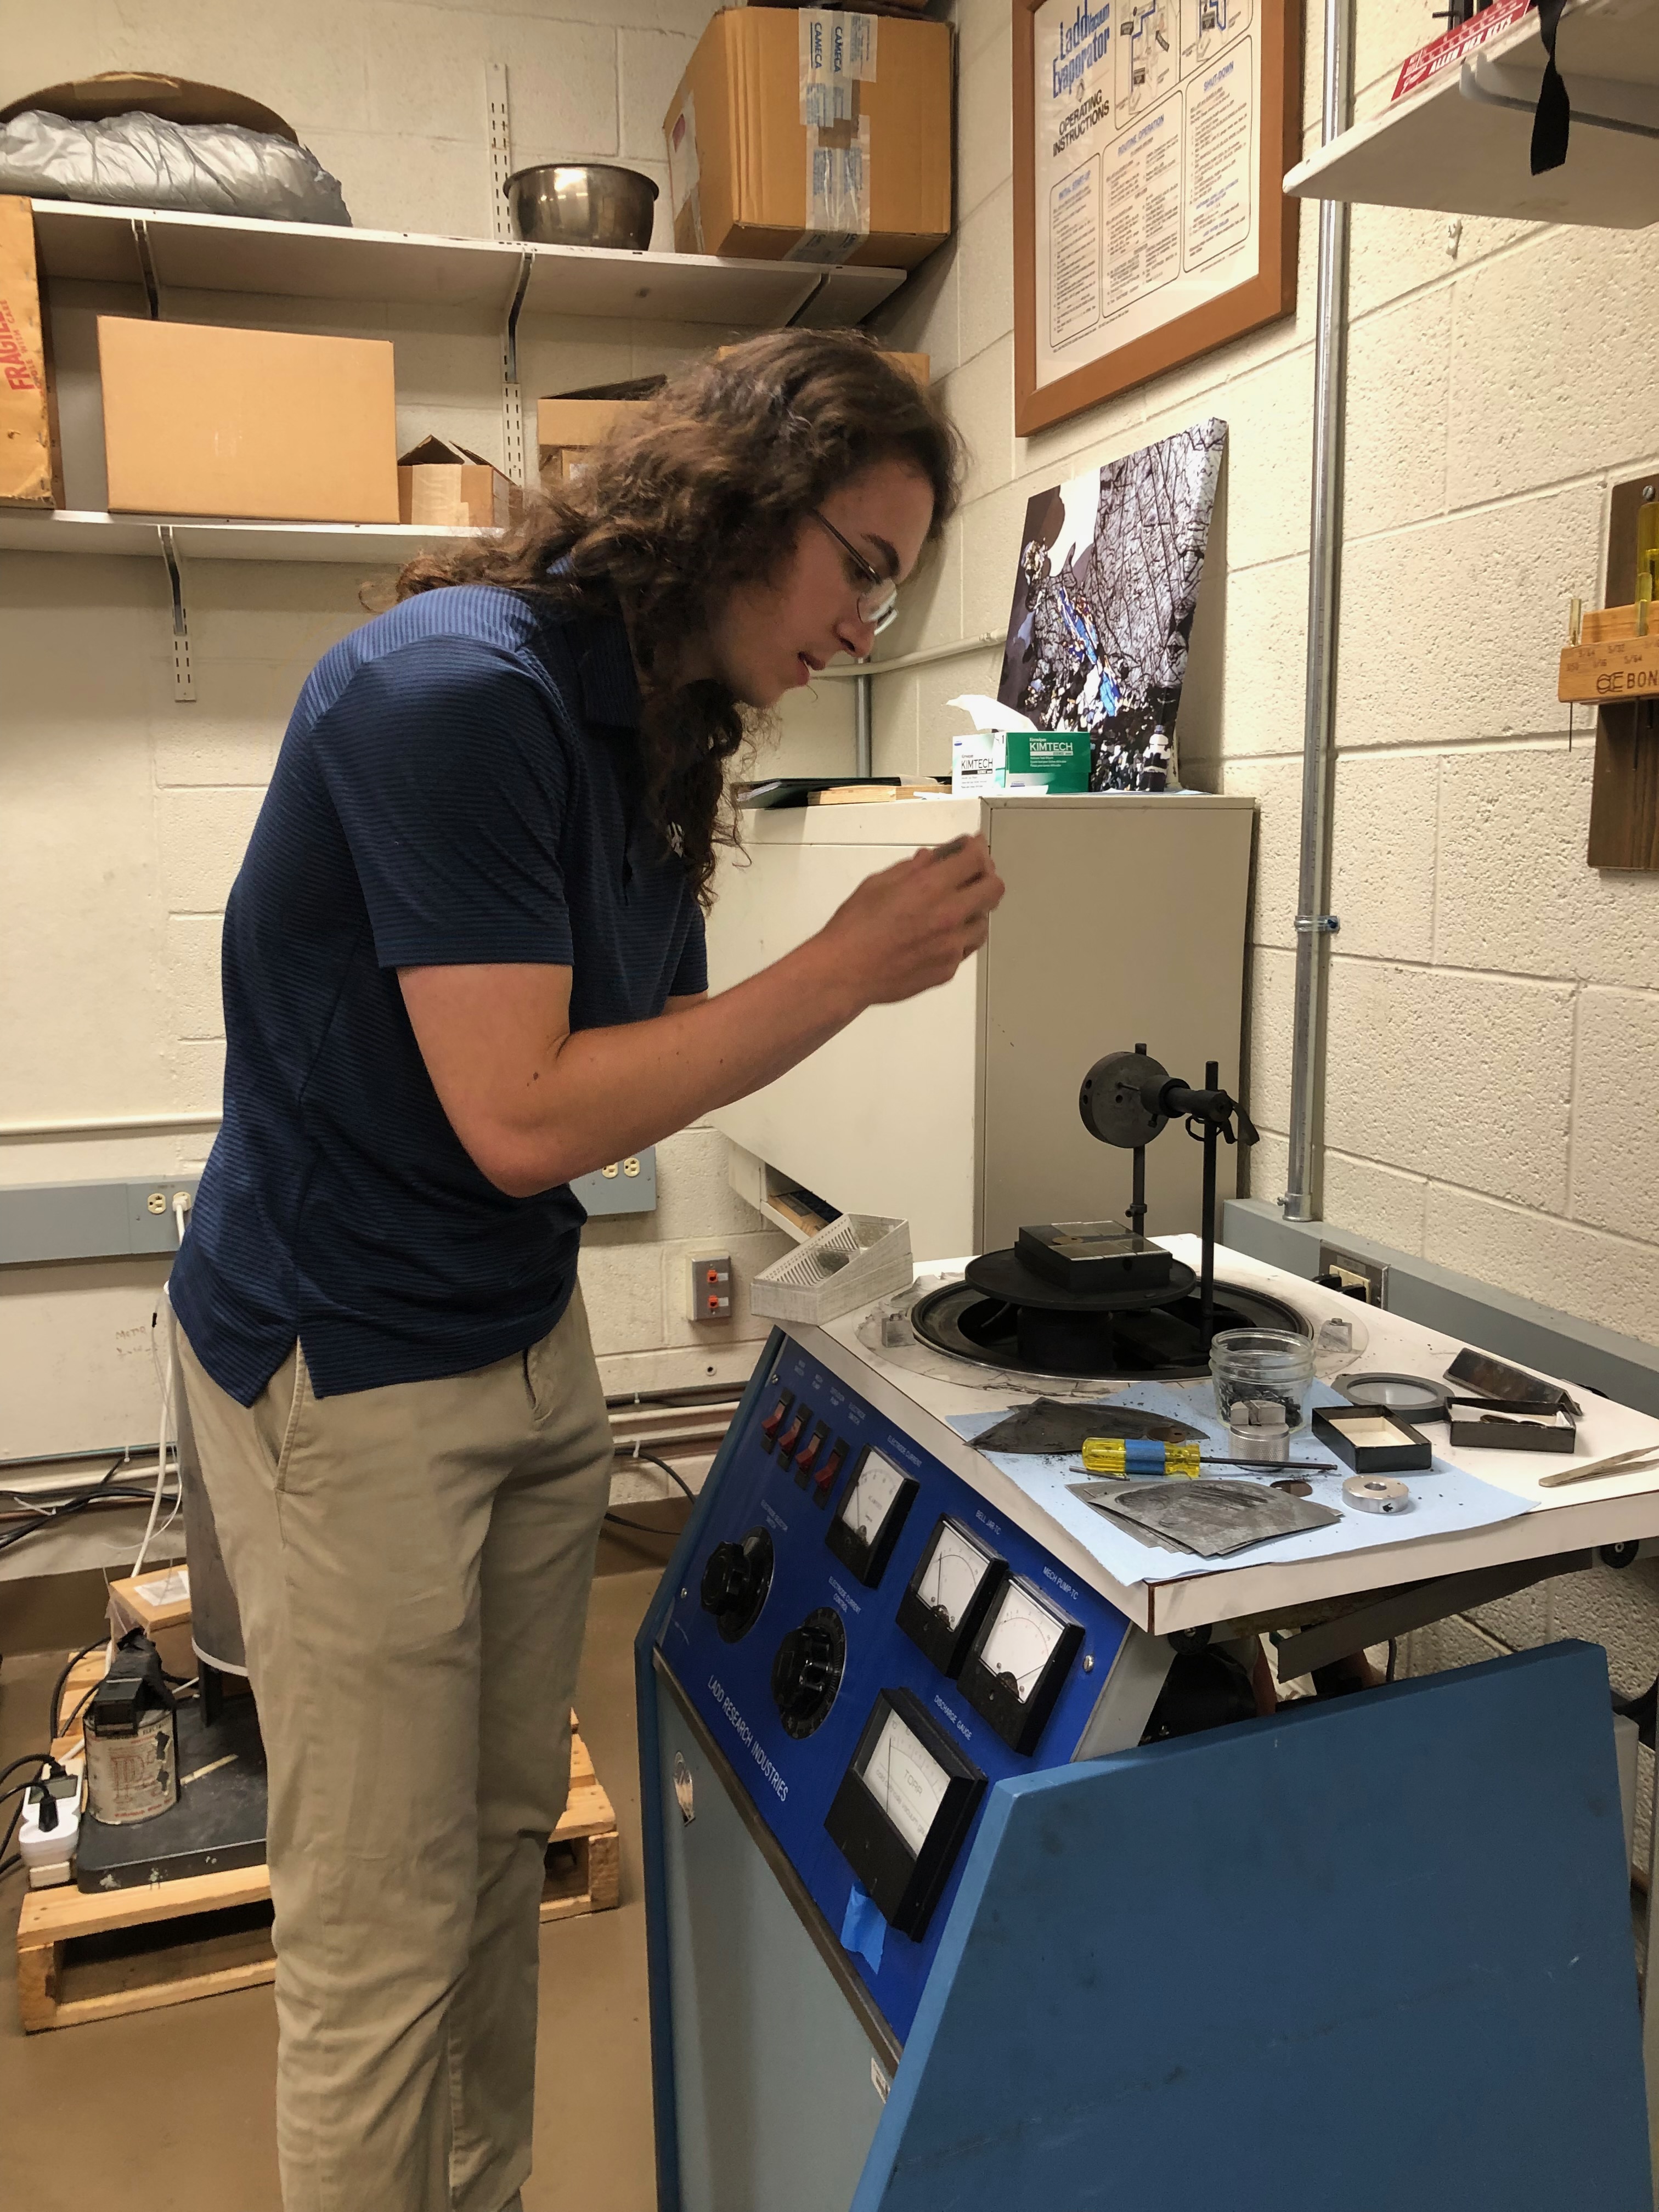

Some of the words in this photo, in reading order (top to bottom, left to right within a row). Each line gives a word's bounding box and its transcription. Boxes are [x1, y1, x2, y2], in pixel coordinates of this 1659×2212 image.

[834, 26, 843, 73] CAMECA
[1060, 0, 1088, 60] Ladd
[1087, 3, 1110, 33] Vacuum
[1428, 46, 1460, 75] ALLEN
[1485, 14, 1513, 42] KEYS
[1053, 26, 1110, 99] Evaporator
[1204, 60, 1234, 92] SHUT-DOWN
[1053, 100, 1110, 157] INSTRUCTIONS
[1059, 89, 1102, 136] OPERATING
[961, 758, 993, 770] KIMTECH
[1029, 742, 1073, 751] KIMTECH
[887, 1435, 907, 1455] ELECTRODE
[905, 1450, 922, 1468] CURRENT
[975, 1510, 986, 1523] BELL
[986, 1519, 1001, 1535] JAR-TC
[828, 1576, 847, 1599] ELECTRODE
[845, 1594, 861, 1615] CURRENT
[1043, 1566, 1058, 1583] MECH
[1056, 1577, 1079, 1600] PUMP-TC
[833, 1593, 848, 1613] CONTROL
[934, 1695, 957, 1724] DISCHARGE
[956, 1720, 972, 1741] GAUGE
[708, 1675, 725, 1702] LADD
[722, 1697, 753, 1748] RESEARCH
[751, 1741, 788, 1802] INDUSTRIES
[905, 1769, 923, 1798] TORR
